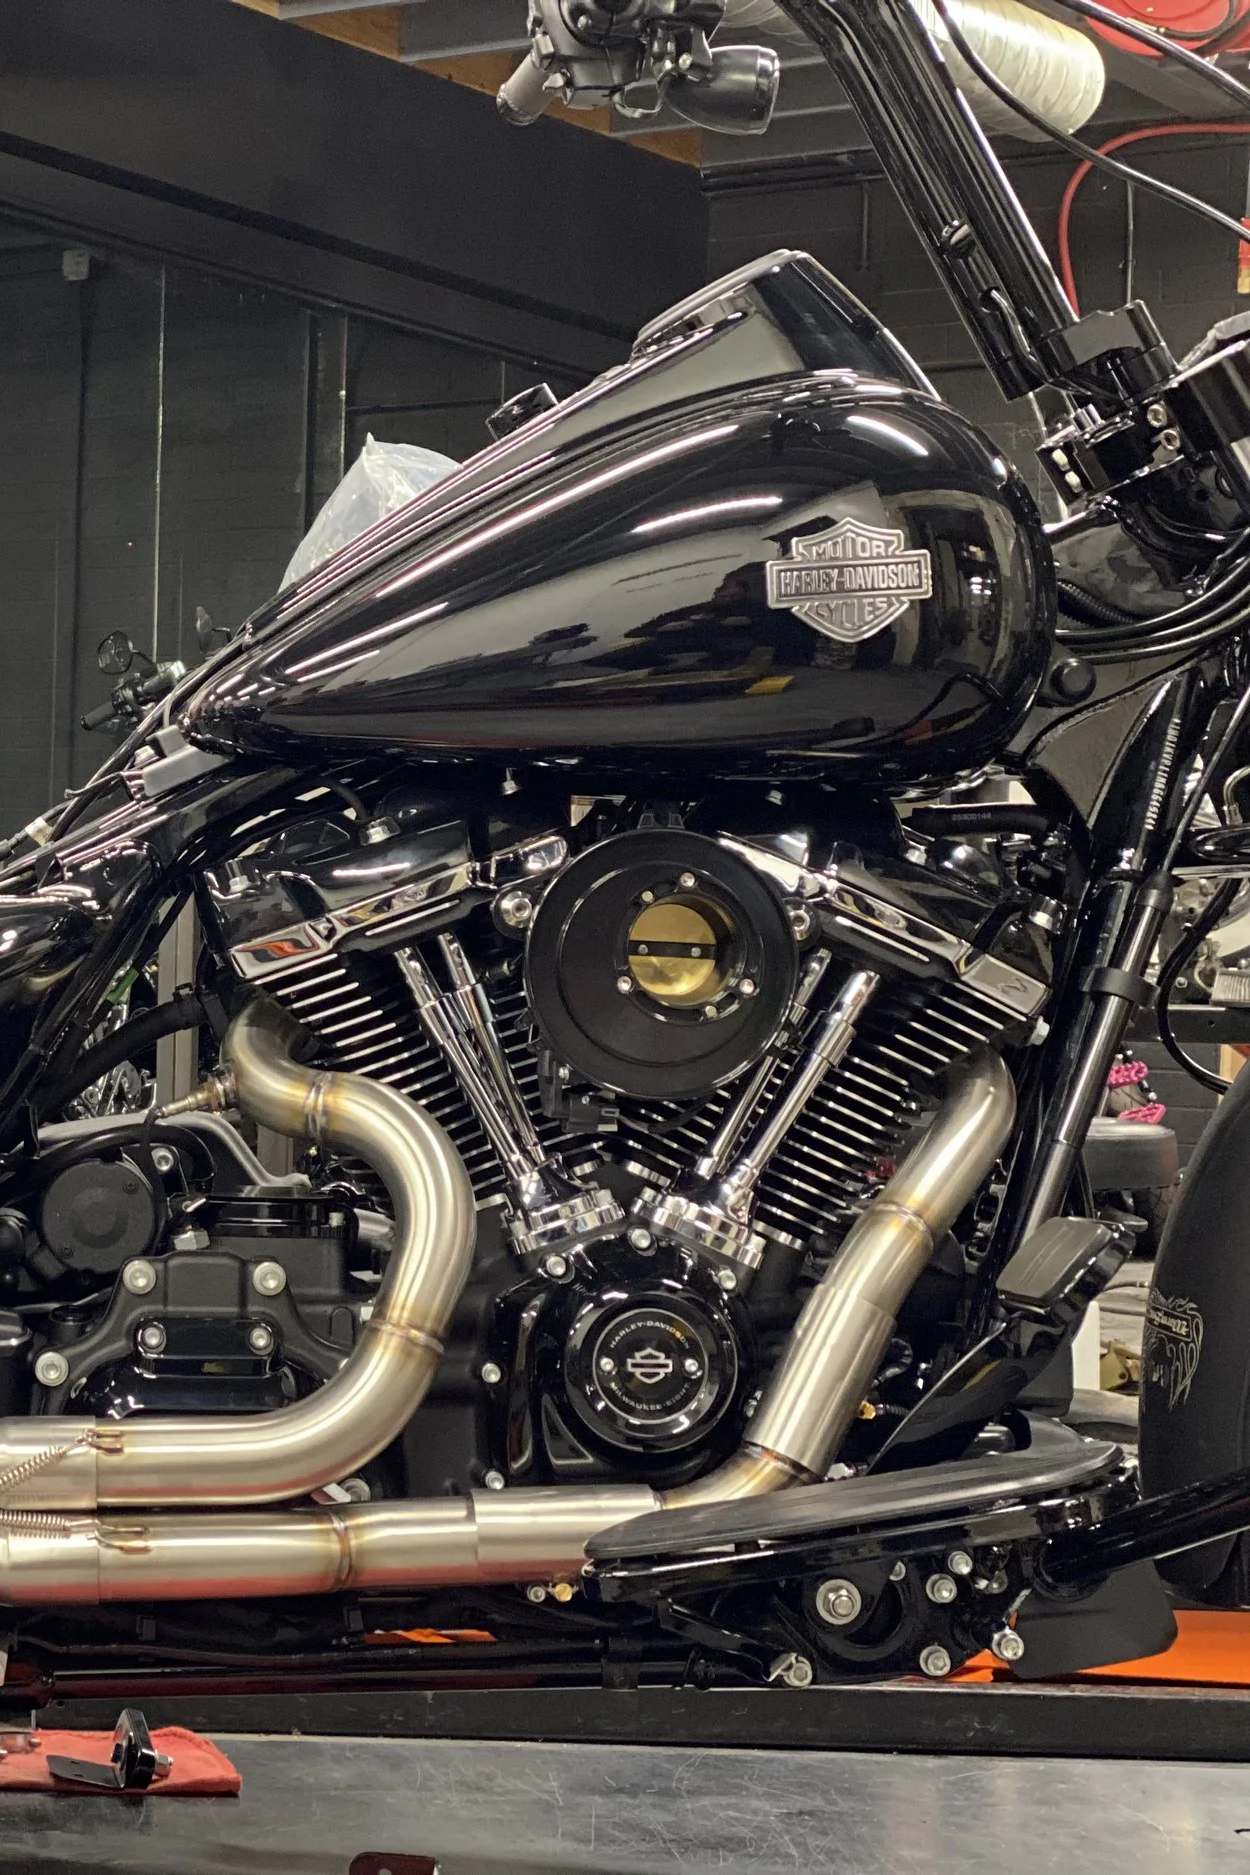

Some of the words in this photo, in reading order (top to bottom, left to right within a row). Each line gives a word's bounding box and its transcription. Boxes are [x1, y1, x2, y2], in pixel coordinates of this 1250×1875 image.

[812, 532, 889, 561] MOTOR
[780, 562, 920, 595] HARLEY-DAVIDSON
[814, 597, 887, 628] CYCLES
[610, 1320, 689, 1349] HARLEY-DAVIDSON
[610, 1382, 691, 1410] MILWAUKEE-EIGHT
